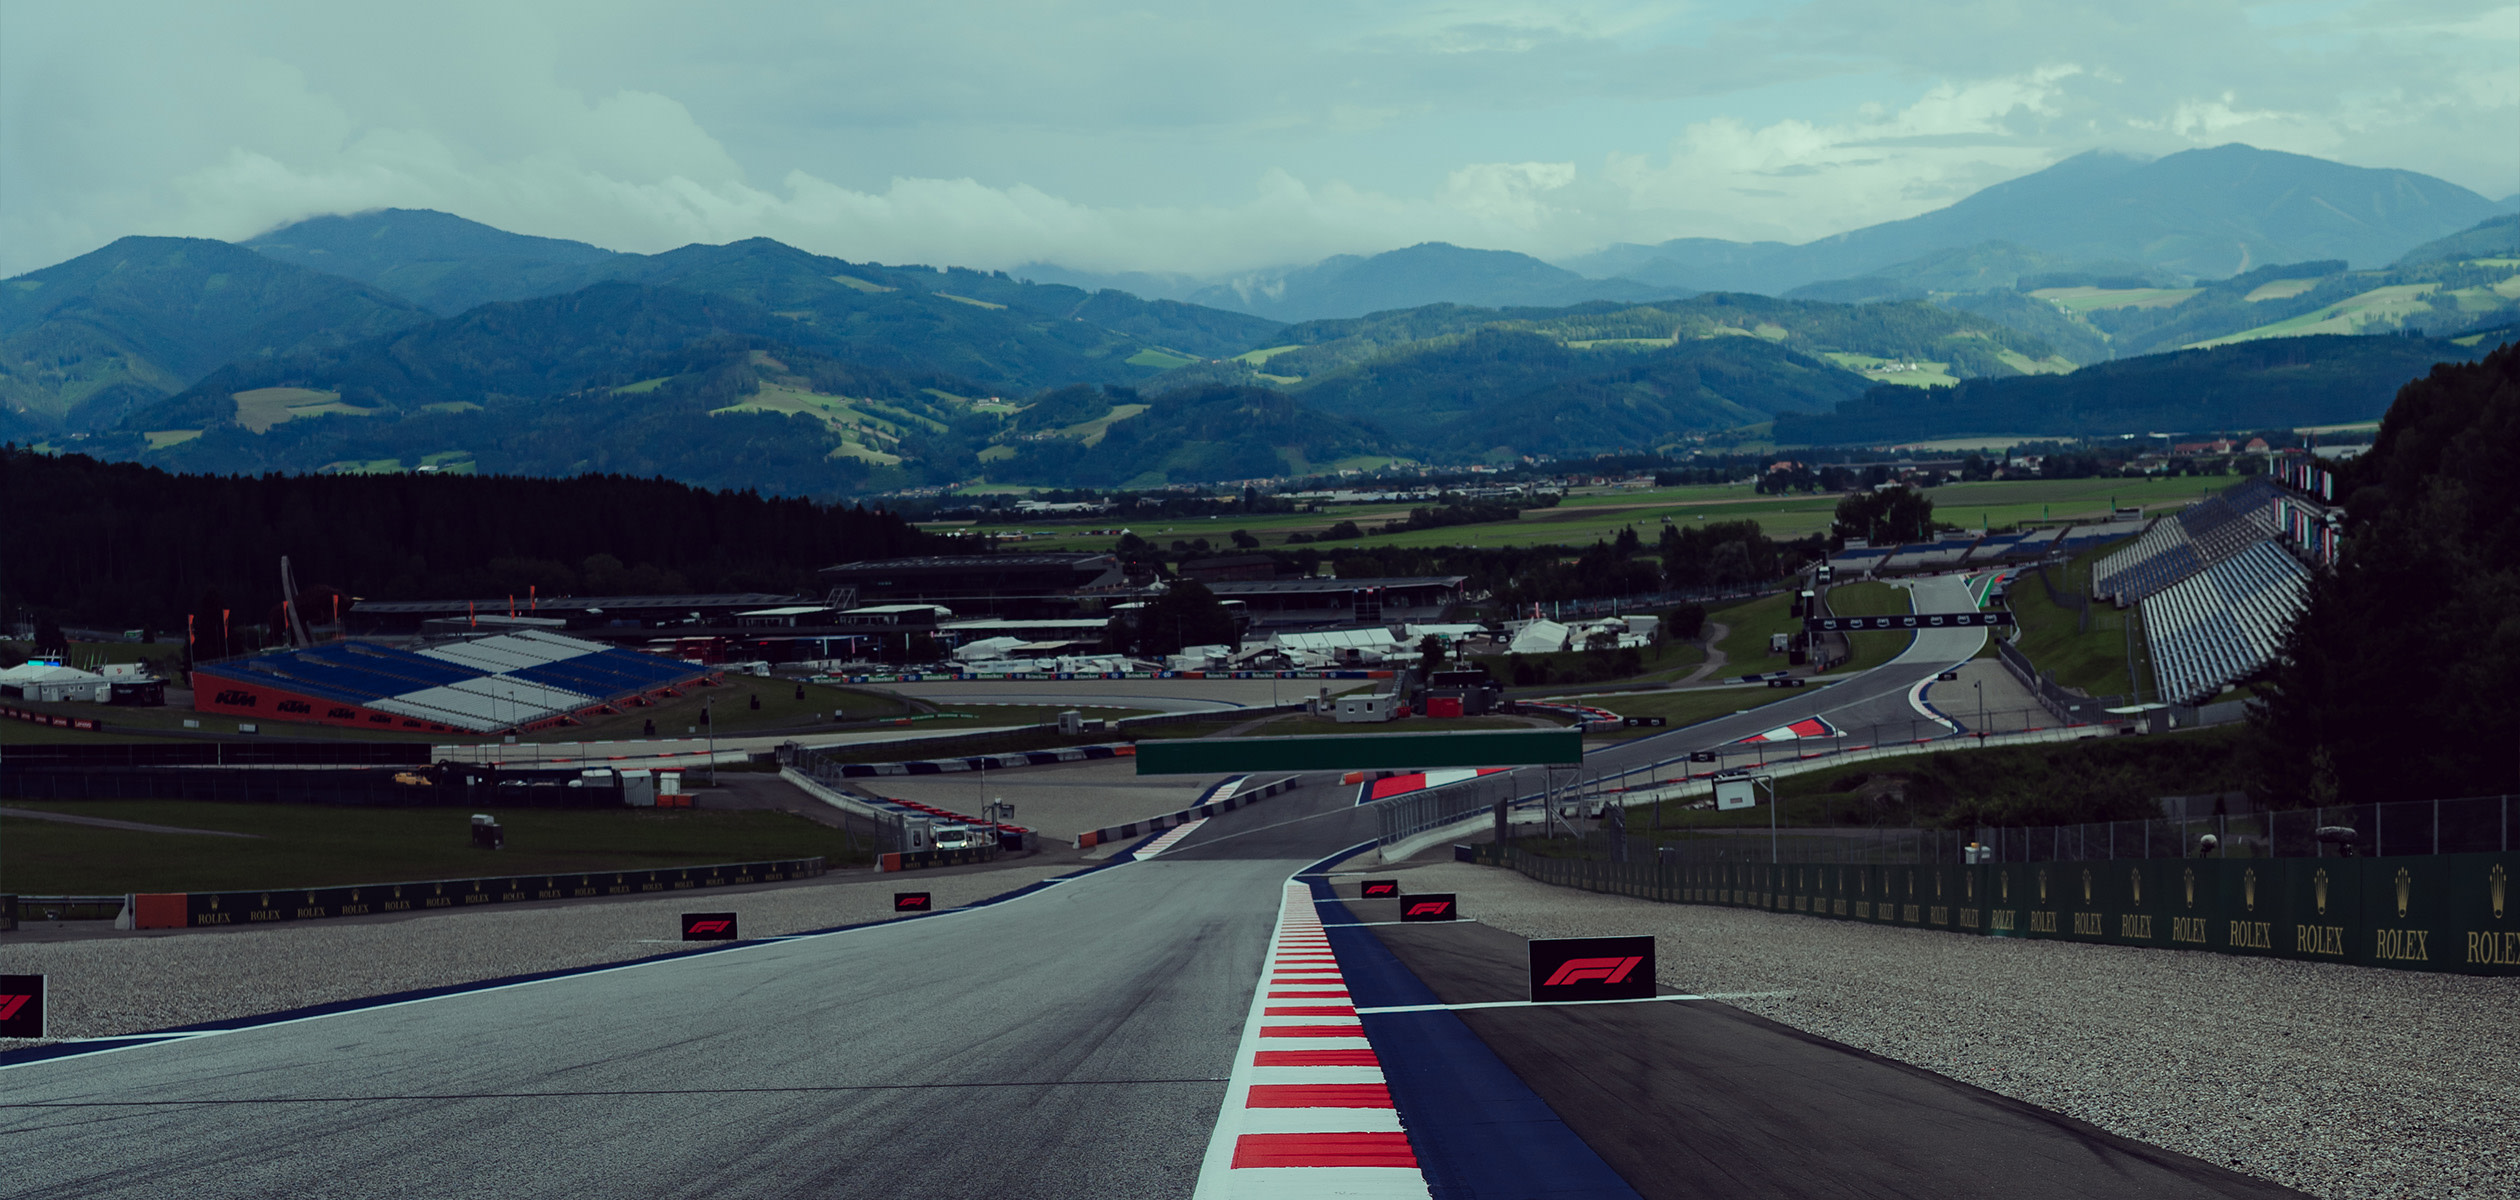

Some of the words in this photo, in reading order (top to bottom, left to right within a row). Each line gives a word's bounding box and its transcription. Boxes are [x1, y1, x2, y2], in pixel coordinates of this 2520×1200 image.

[215, 690, 257, 707] KTM
[277, 700, 311, 714] KTM
[327, 708, 355, 719] KTM
[426, 897, 451, 907] ROLEX
[465, 893, 489, 904] ROLEX
[503, 892, 525, 901] ROLEX
[539, 890, 561, 899] ROLEX
[297, 907, 325, 918] ROLEX
[342, 904, 369, 915] ROLEX
[385, 900, 410, 911] ROLEX
[198, 913, 231, 925] ROLEX
[250, 910, 280, 921] ROLEX
[1930, 906, 1948, 925] ROLEX
[1960, 907, 1979, 928] ROLEX
[1991, 909, 2015, 930] ROLEX
[2030, 911, 2057, 933] ROLEX
[2074, 912, 2102, 935] ROLEX
[2121, 913, 2152, 939] ROLEX
[2172, 916, 2207, 943] ROLEX
[2229, 920, 2272, 949] ROLEX
[2297, 924, 2344, 955] ROLEX
[2376, 928, 2429, 960] ROLEX
[2467, 931, 2520, 965] ROLE
[1543, 956, 1645, 986] F1
